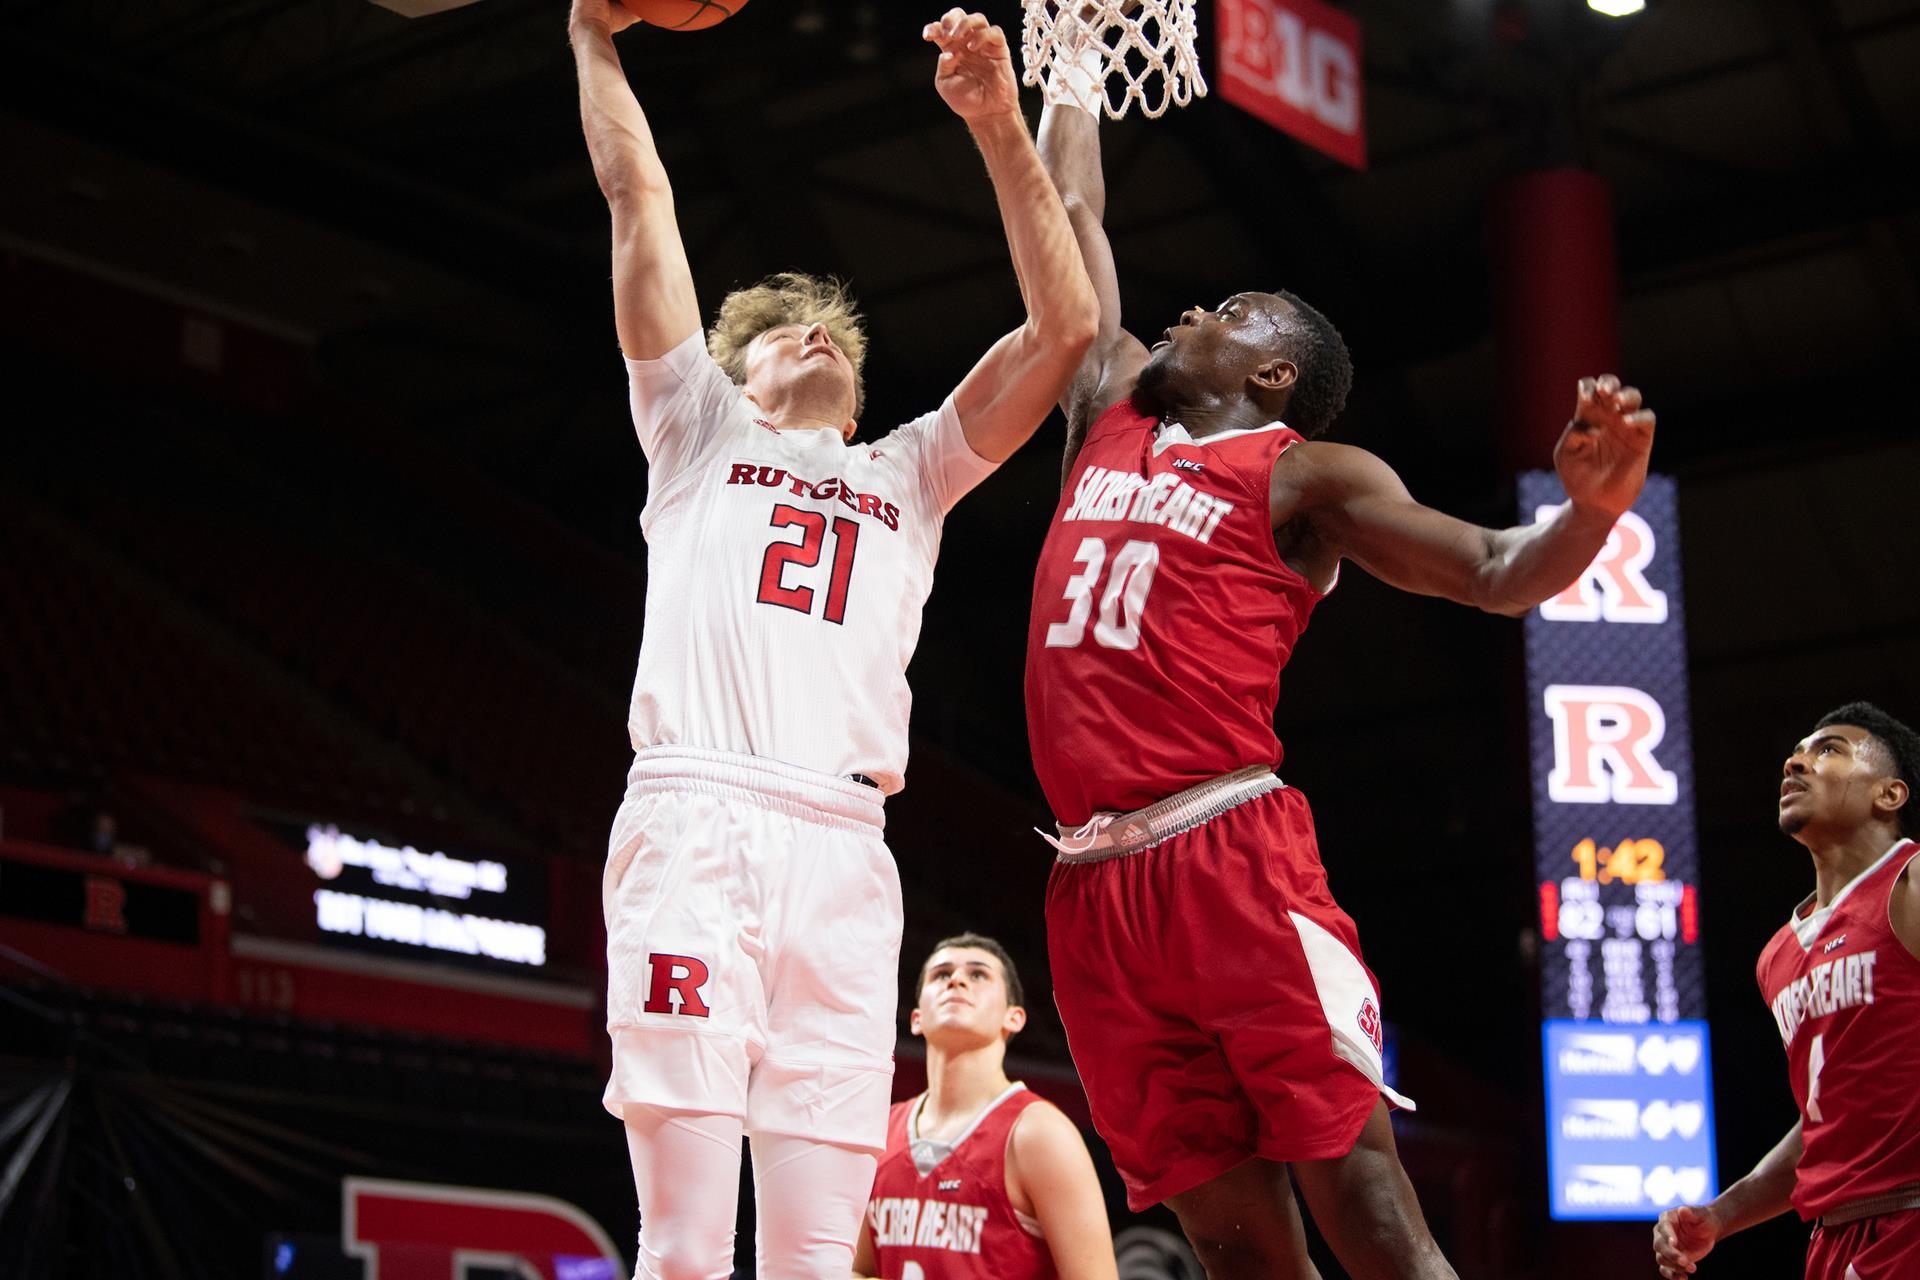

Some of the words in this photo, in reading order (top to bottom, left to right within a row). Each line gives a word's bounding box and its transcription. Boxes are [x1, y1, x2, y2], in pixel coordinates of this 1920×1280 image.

[726, 463, 900, 532] RUTGERS
[1127, 472, 1235, 545] HEART
[756, 503, 860, 626] 21
[1045, 537, 1160, 651] 30
[1544, 684, 1678, 805] R
[1571, 837, 1666, 885] 1:42
[644, 953, 710, 1018] R
[1808, 951, 1877, 1020] HEART
[1806, 1033, 1826, 1124] 1
[915, 1199, 989, 1255] HEART
